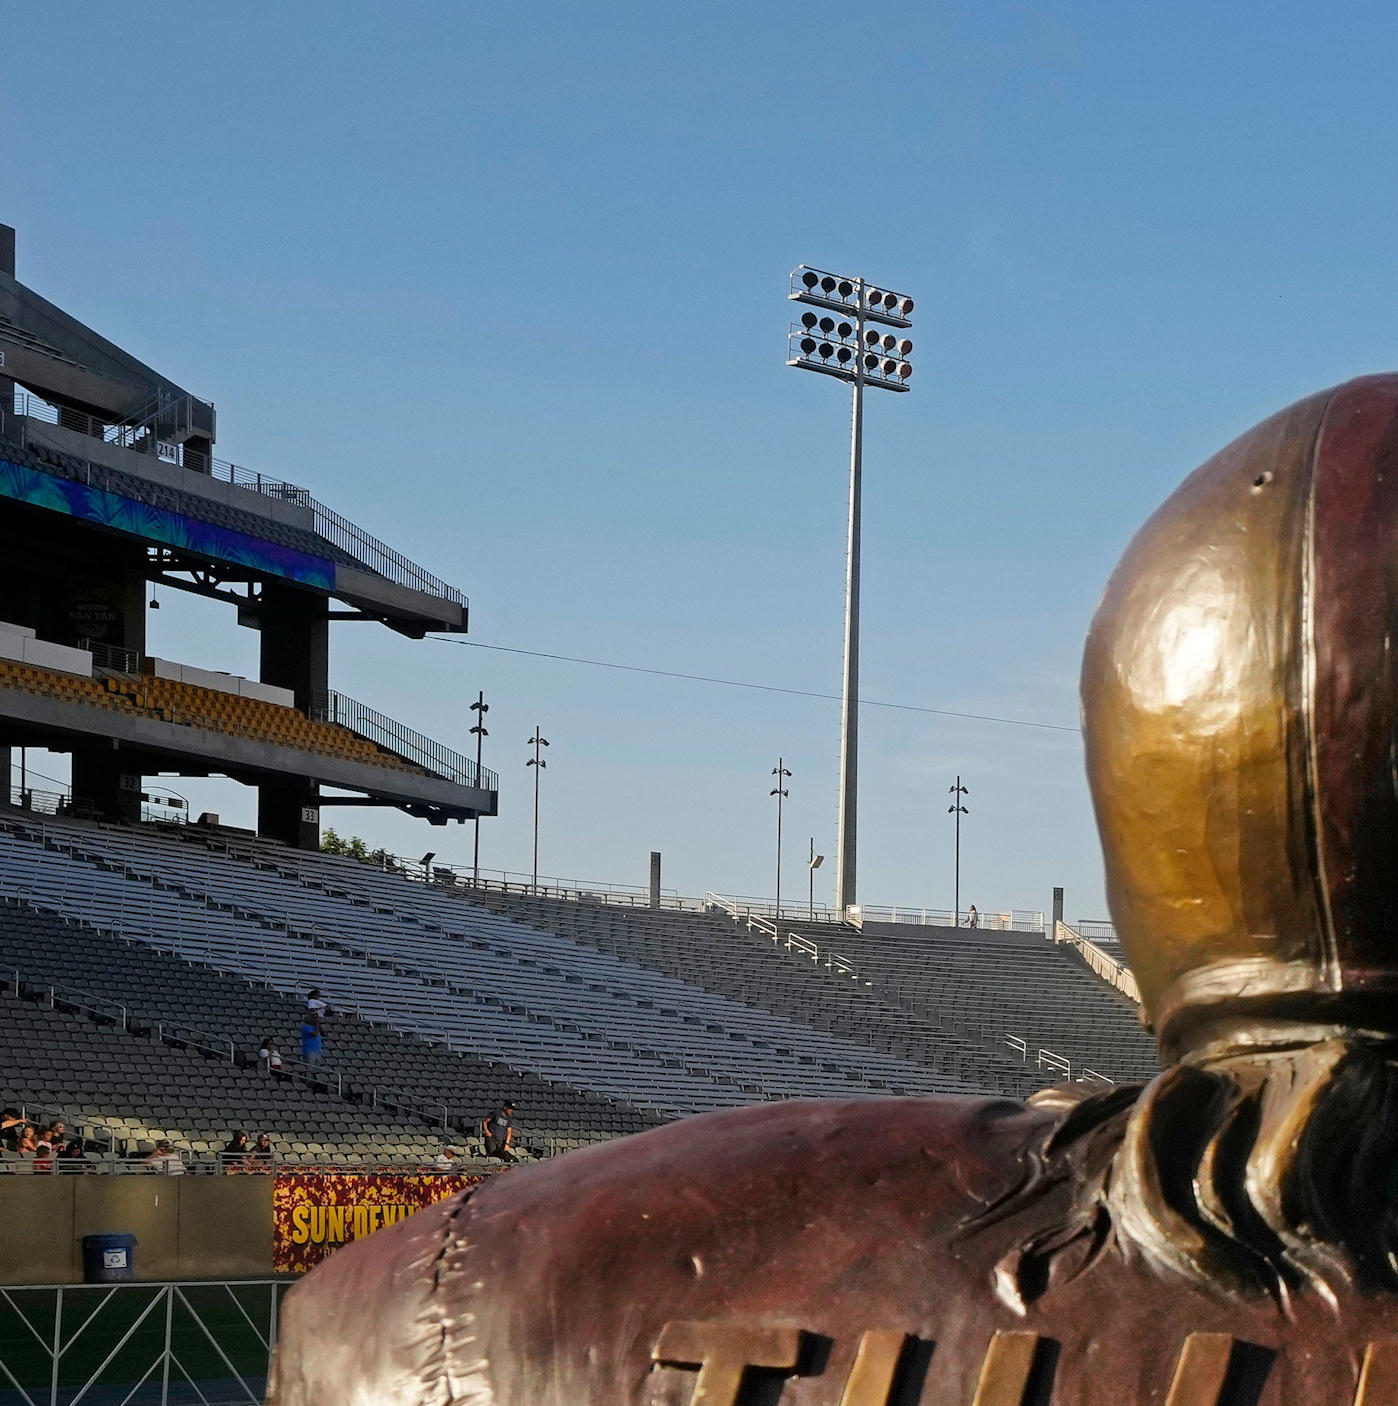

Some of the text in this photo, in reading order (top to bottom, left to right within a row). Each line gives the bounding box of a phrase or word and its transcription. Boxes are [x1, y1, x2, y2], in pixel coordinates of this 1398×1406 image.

[158, 443, 175, 459] 214
[293, 1205, 415, 1244] SUN DEV
